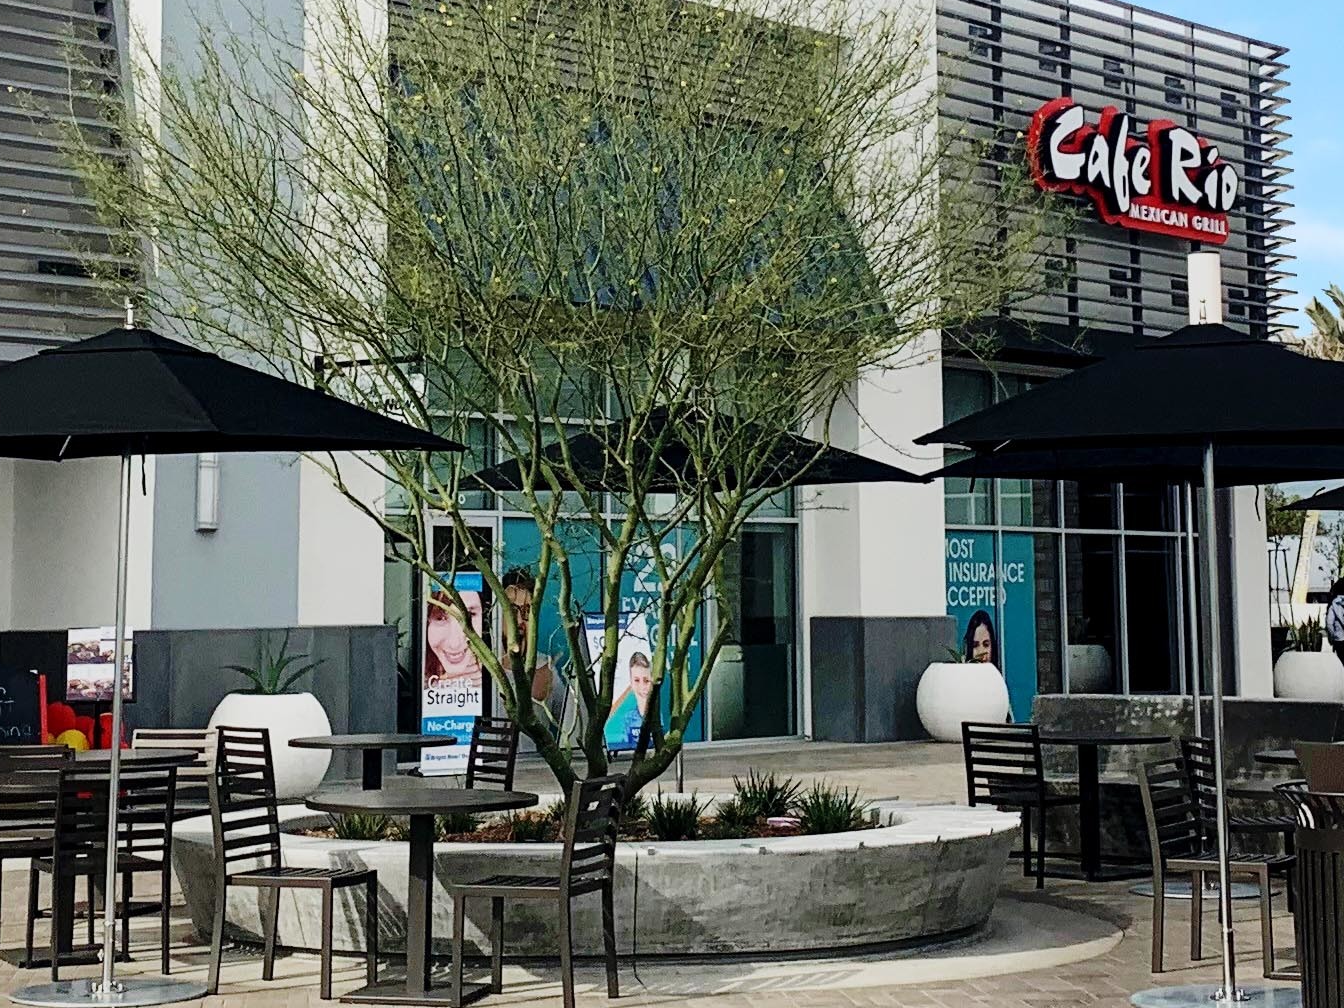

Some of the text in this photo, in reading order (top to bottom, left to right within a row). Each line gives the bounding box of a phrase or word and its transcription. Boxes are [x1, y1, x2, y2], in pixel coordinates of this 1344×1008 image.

[1050, 106, 1238, 212] Cafe Rio
[1129, 203, 1228, 236] MEXICAN GRILL
[945, 538, 975, 558] OST
[949, 562, 1025, 583] INSURANCE
[946, 586, 1007, 606] CCEPTED
[428, 675, 473, 689] Create
[427, 688, 479, 707] Straight
[427, 719, 474, 732] No-Charg
